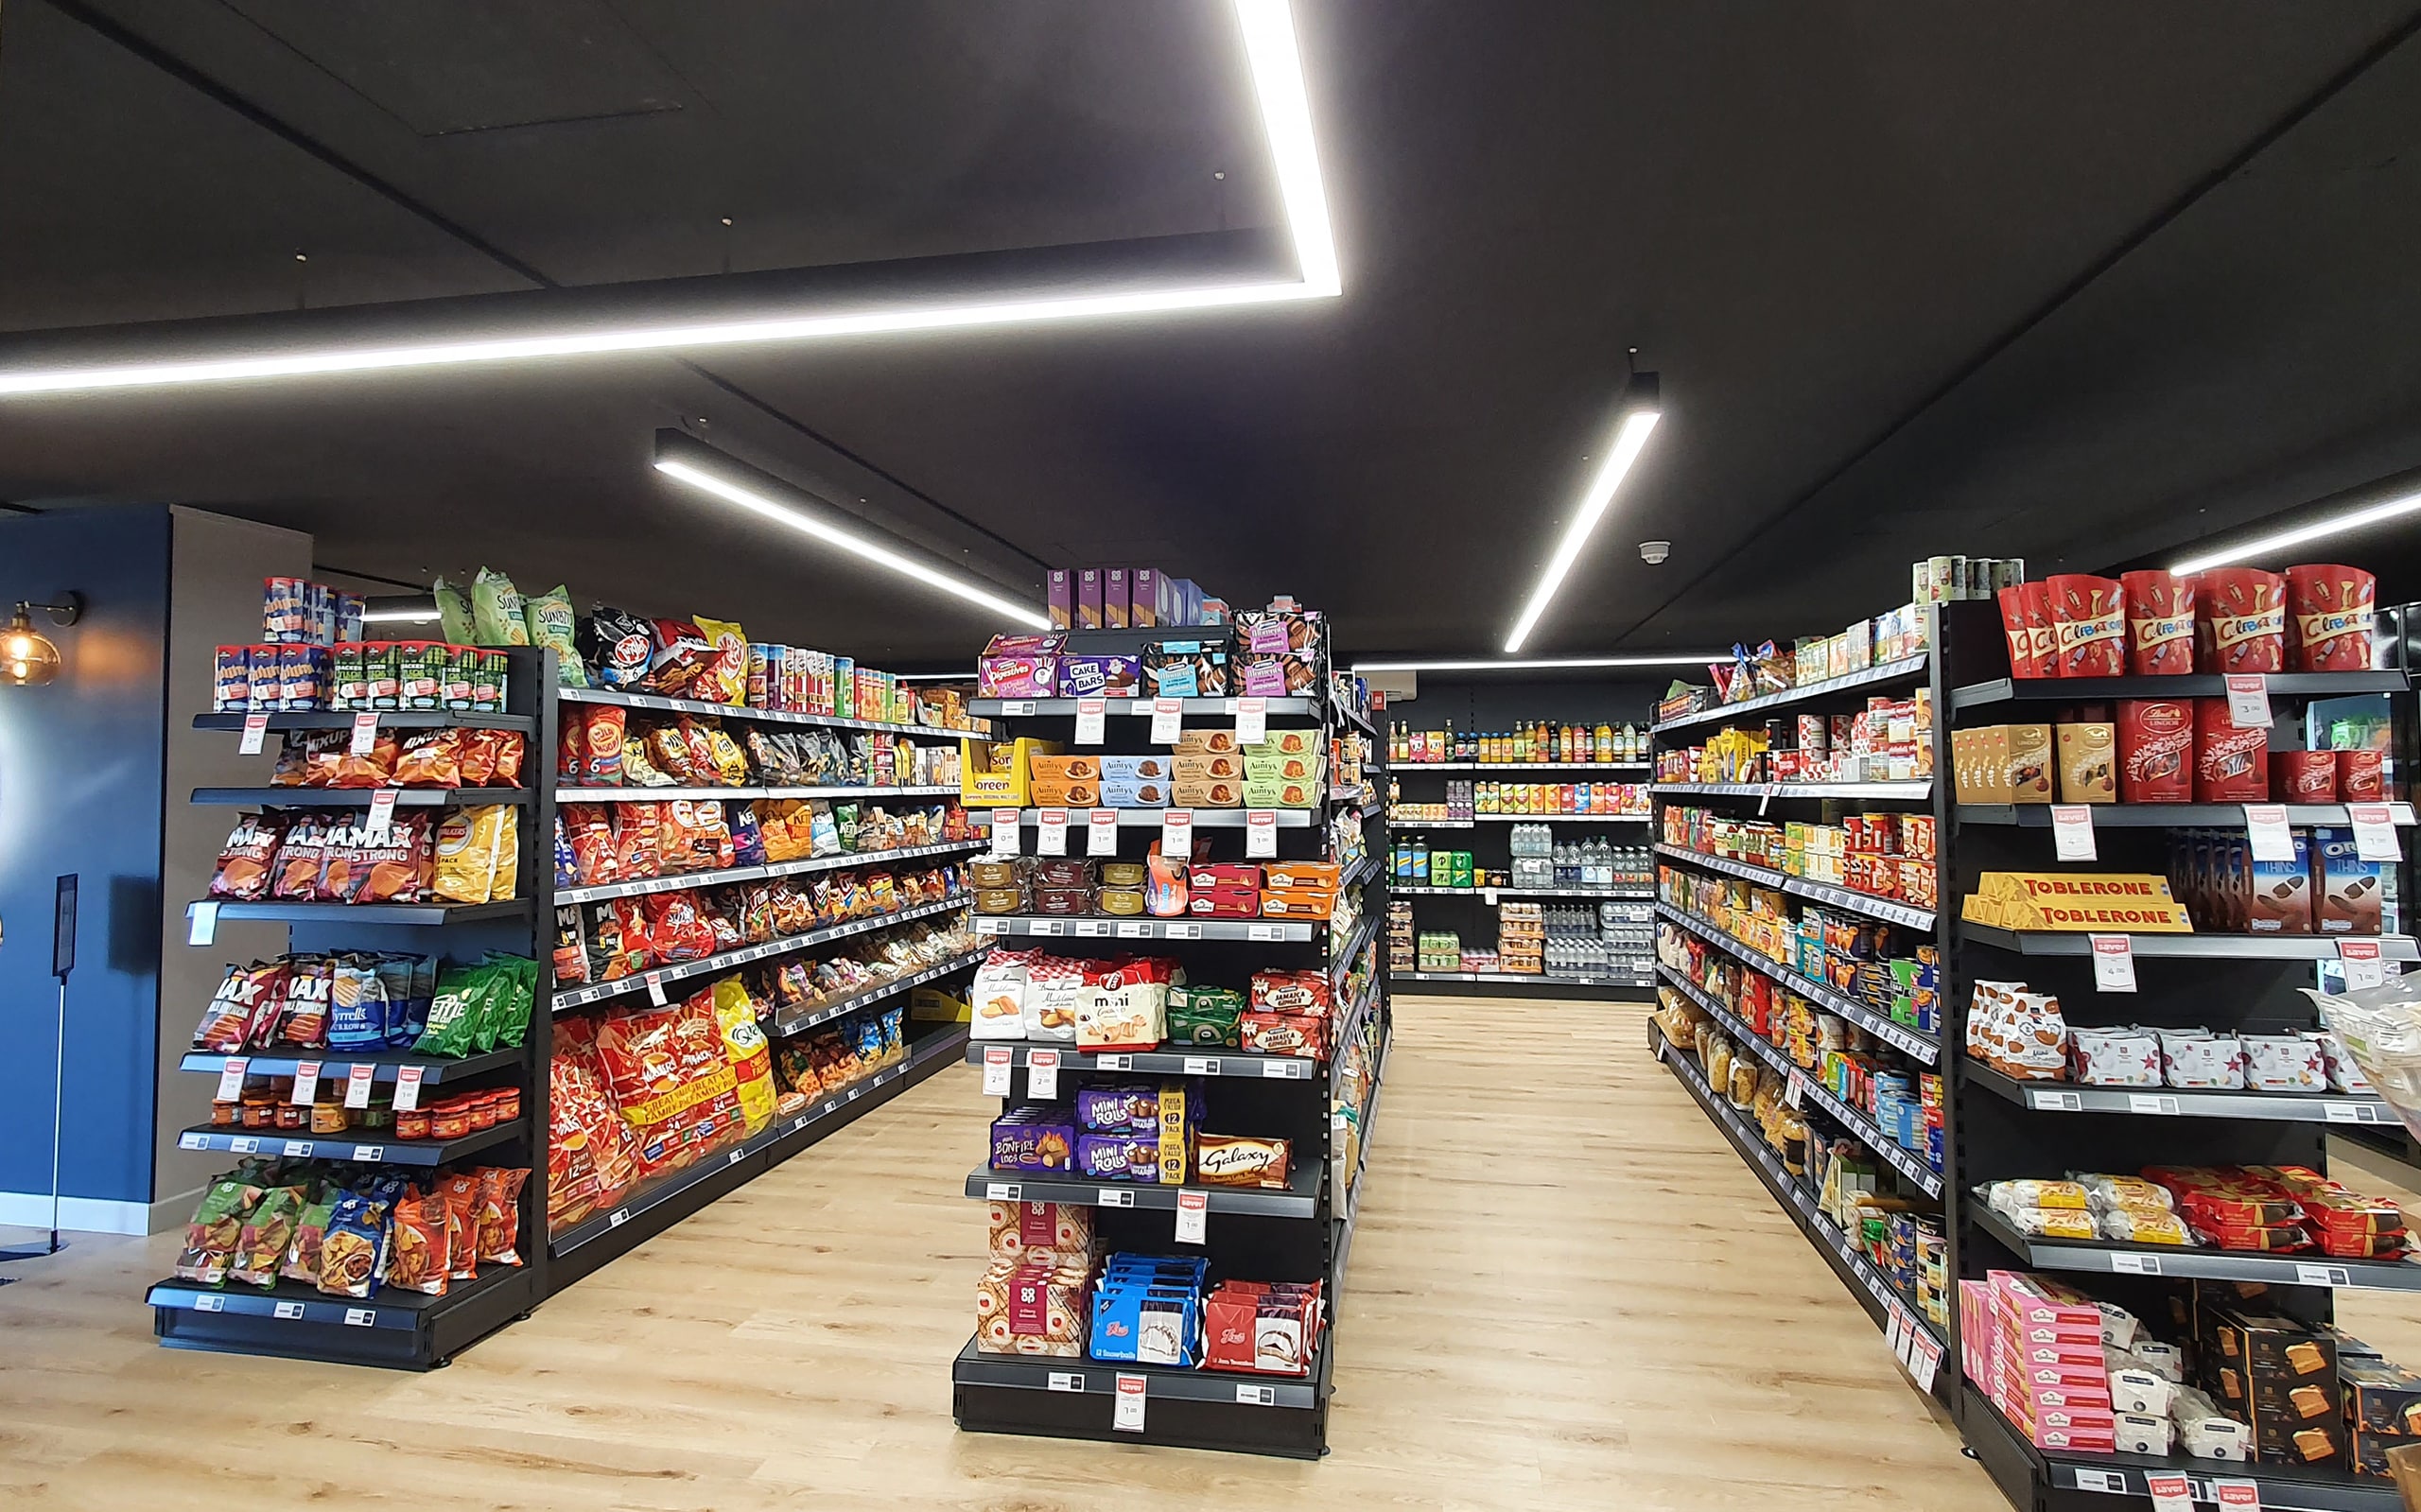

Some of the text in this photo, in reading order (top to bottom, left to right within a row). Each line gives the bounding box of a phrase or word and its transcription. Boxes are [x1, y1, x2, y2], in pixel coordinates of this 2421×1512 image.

[1071, 664, 1097, 677] CAKE
[1078, 674, 1104, 688] BARS
[307, 730, 351, 752] MIXUP
[568, 759, 579, 774] 6
[589, 757, 601, 773] 6
[975, 779, 1010, 791] oreen
[351, 826, 413, 849] MAX
[352, 849, 408, 861] STRONG
[2024, 879, 2153, 896] TOBLERONE
[2040, 907, 2172, 925] TOBLERONE
[1275, 991, 1306, 1001] JAMAICA
[1278, 998, 1302, 1007] GINGER
[1264, 1032, 1296, 1042] JAMAICA
[644, 1094, 676, 1112] GREAT
[713, 1102, 725, 1112] 24
[1091, 1097, 1119, 1118] MINI
[645, 1103, 680, 1122] FAMILY
[1096, 1108, 1128, 1125] ROLLS
[1167, 1114, 1177, 1122] 12
[995, 1139, 1036, 1155] BONFIRE
[1090, 1144, 1118, 1165] MINI
[1001, 1155, 1019, 1164] LOGS
[1095, 1156, 1126, 1172] ROLLS
[1167, 1160, 1177, 1169] 12
[1199, 1147, 1270, 1173] Galaxy
[567, 1164, 580, 1180] 12
[2154, 1486, 2185, 1495] saver
[2222, 1492, 2254, 1502] saver
